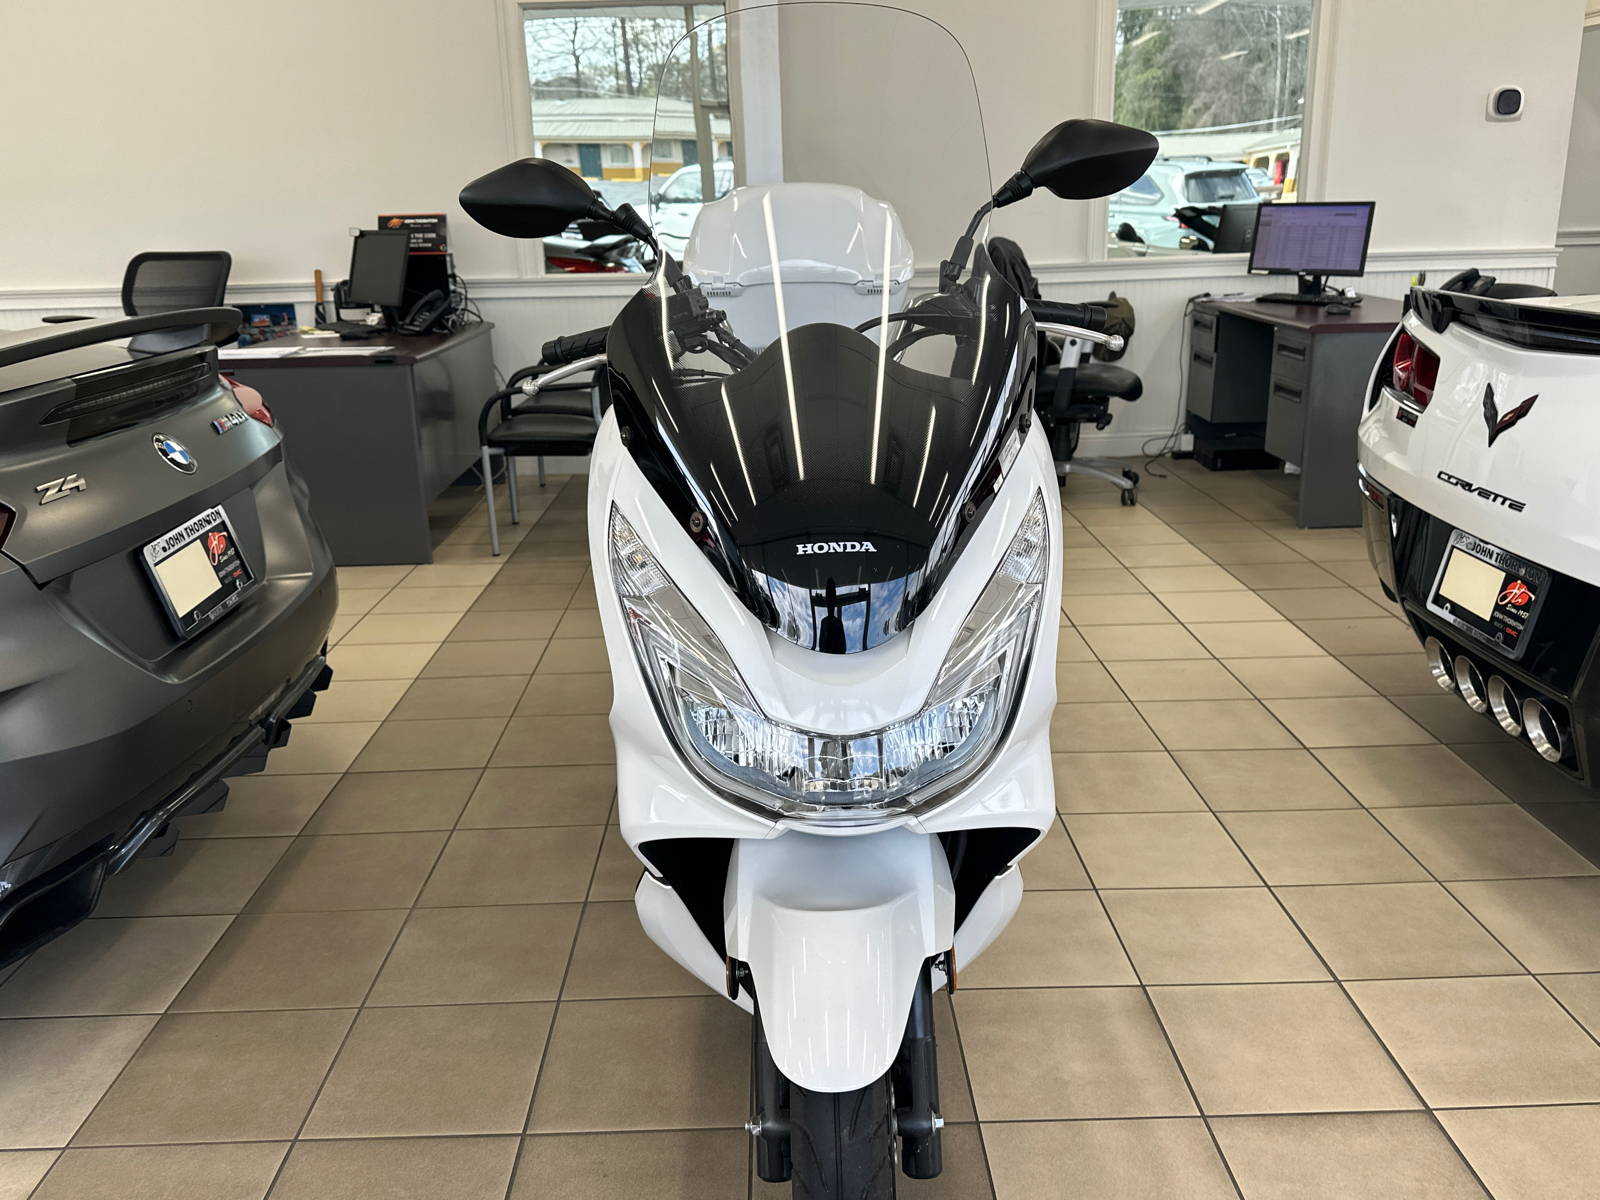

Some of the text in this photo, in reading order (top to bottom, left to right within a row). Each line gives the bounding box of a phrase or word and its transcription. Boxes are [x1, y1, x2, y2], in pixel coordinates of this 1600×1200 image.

[35, 473, 87, 506] Z4
[1437, 470, 1526, 513] CORVETTE
[165, 508, 222, 550] JOHN THORNTON
[796, 541, 877, 555] HONDA
[1471, 540, 1494, 561] JOHN
